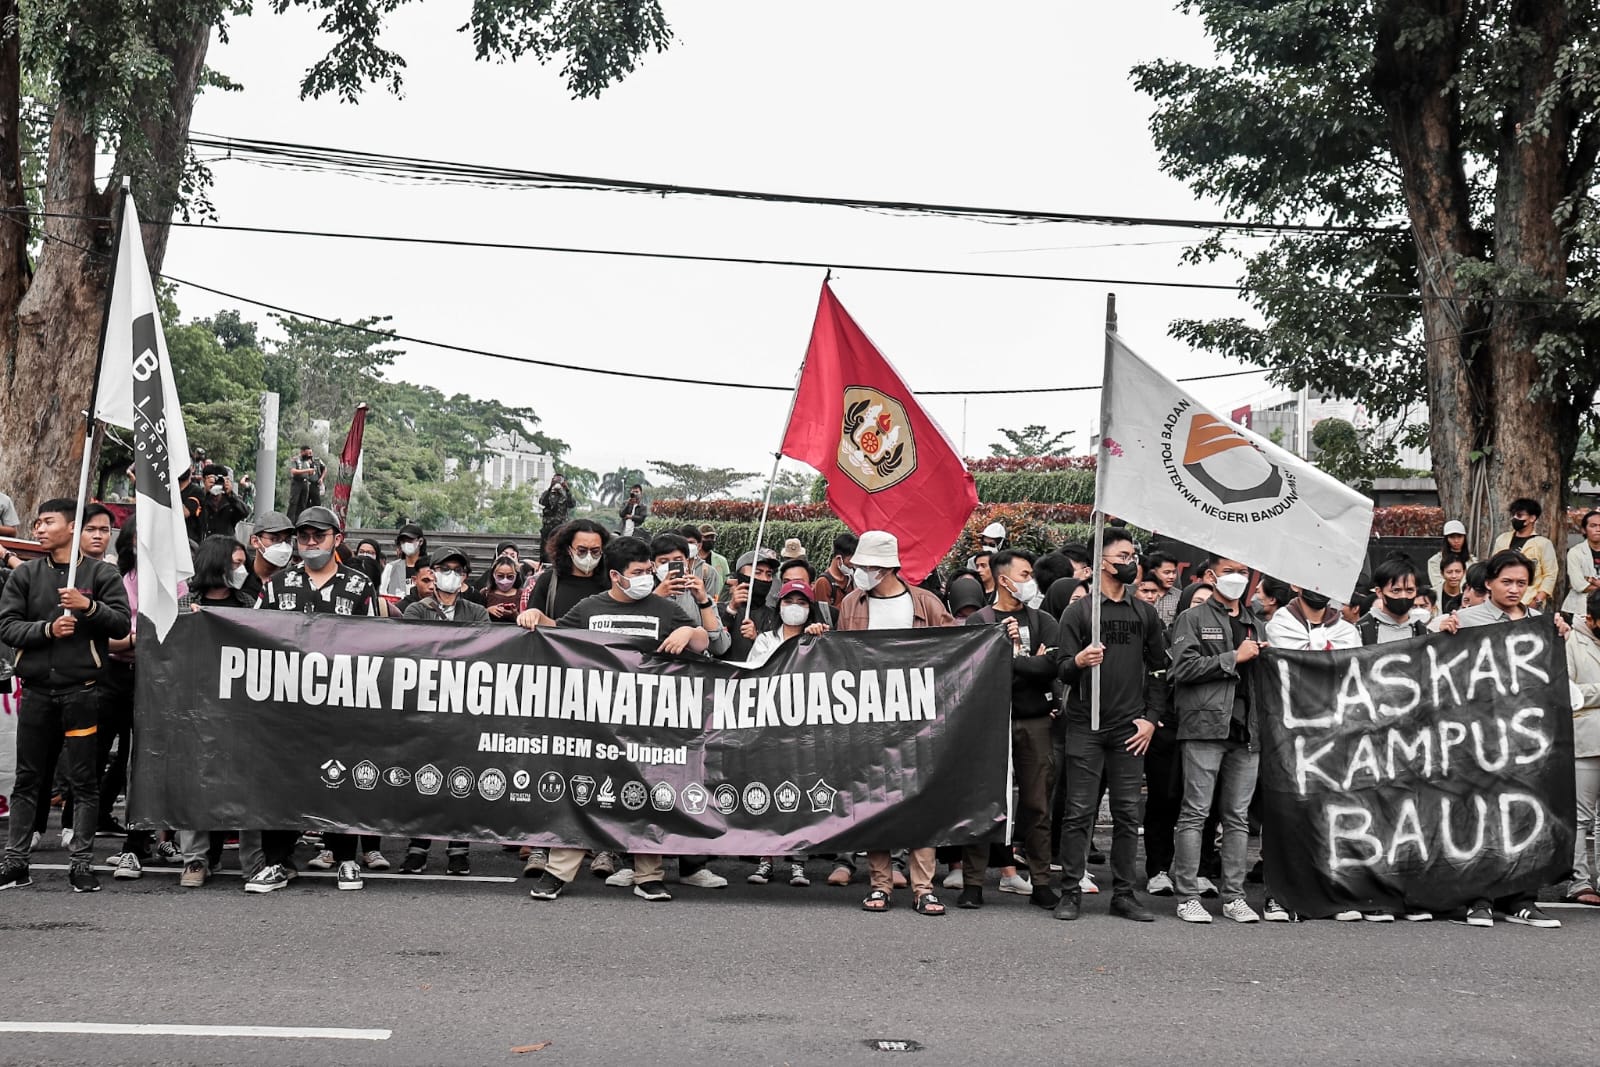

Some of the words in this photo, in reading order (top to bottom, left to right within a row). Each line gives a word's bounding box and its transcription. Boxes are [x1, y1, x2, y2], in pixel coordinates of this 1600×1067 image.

[1161, 399, 1191, 440] BADAN
[1161, 442, 1202, 508] POLITEKNIK
[1200, 502, 1248, 523] NEGERI
[1251, 493, 1298, 522] BANDUN
[219, 646, 383, 709] PUNCAK
[391, 657, 704, 729] PENGKHIANATAN
[712, 667, 937, 729] KEKUASAAN
[1277, 633, 1549, 729] LASKAR
[478, 732, 549, 755] Aliansi
[552, 735, 593, 758] BEM
[595, 742, 688, 765] se-Unpad
[1294, 707, 1550, 796] KAMPUS
[1326, 793, 1545, 871] BAUD
